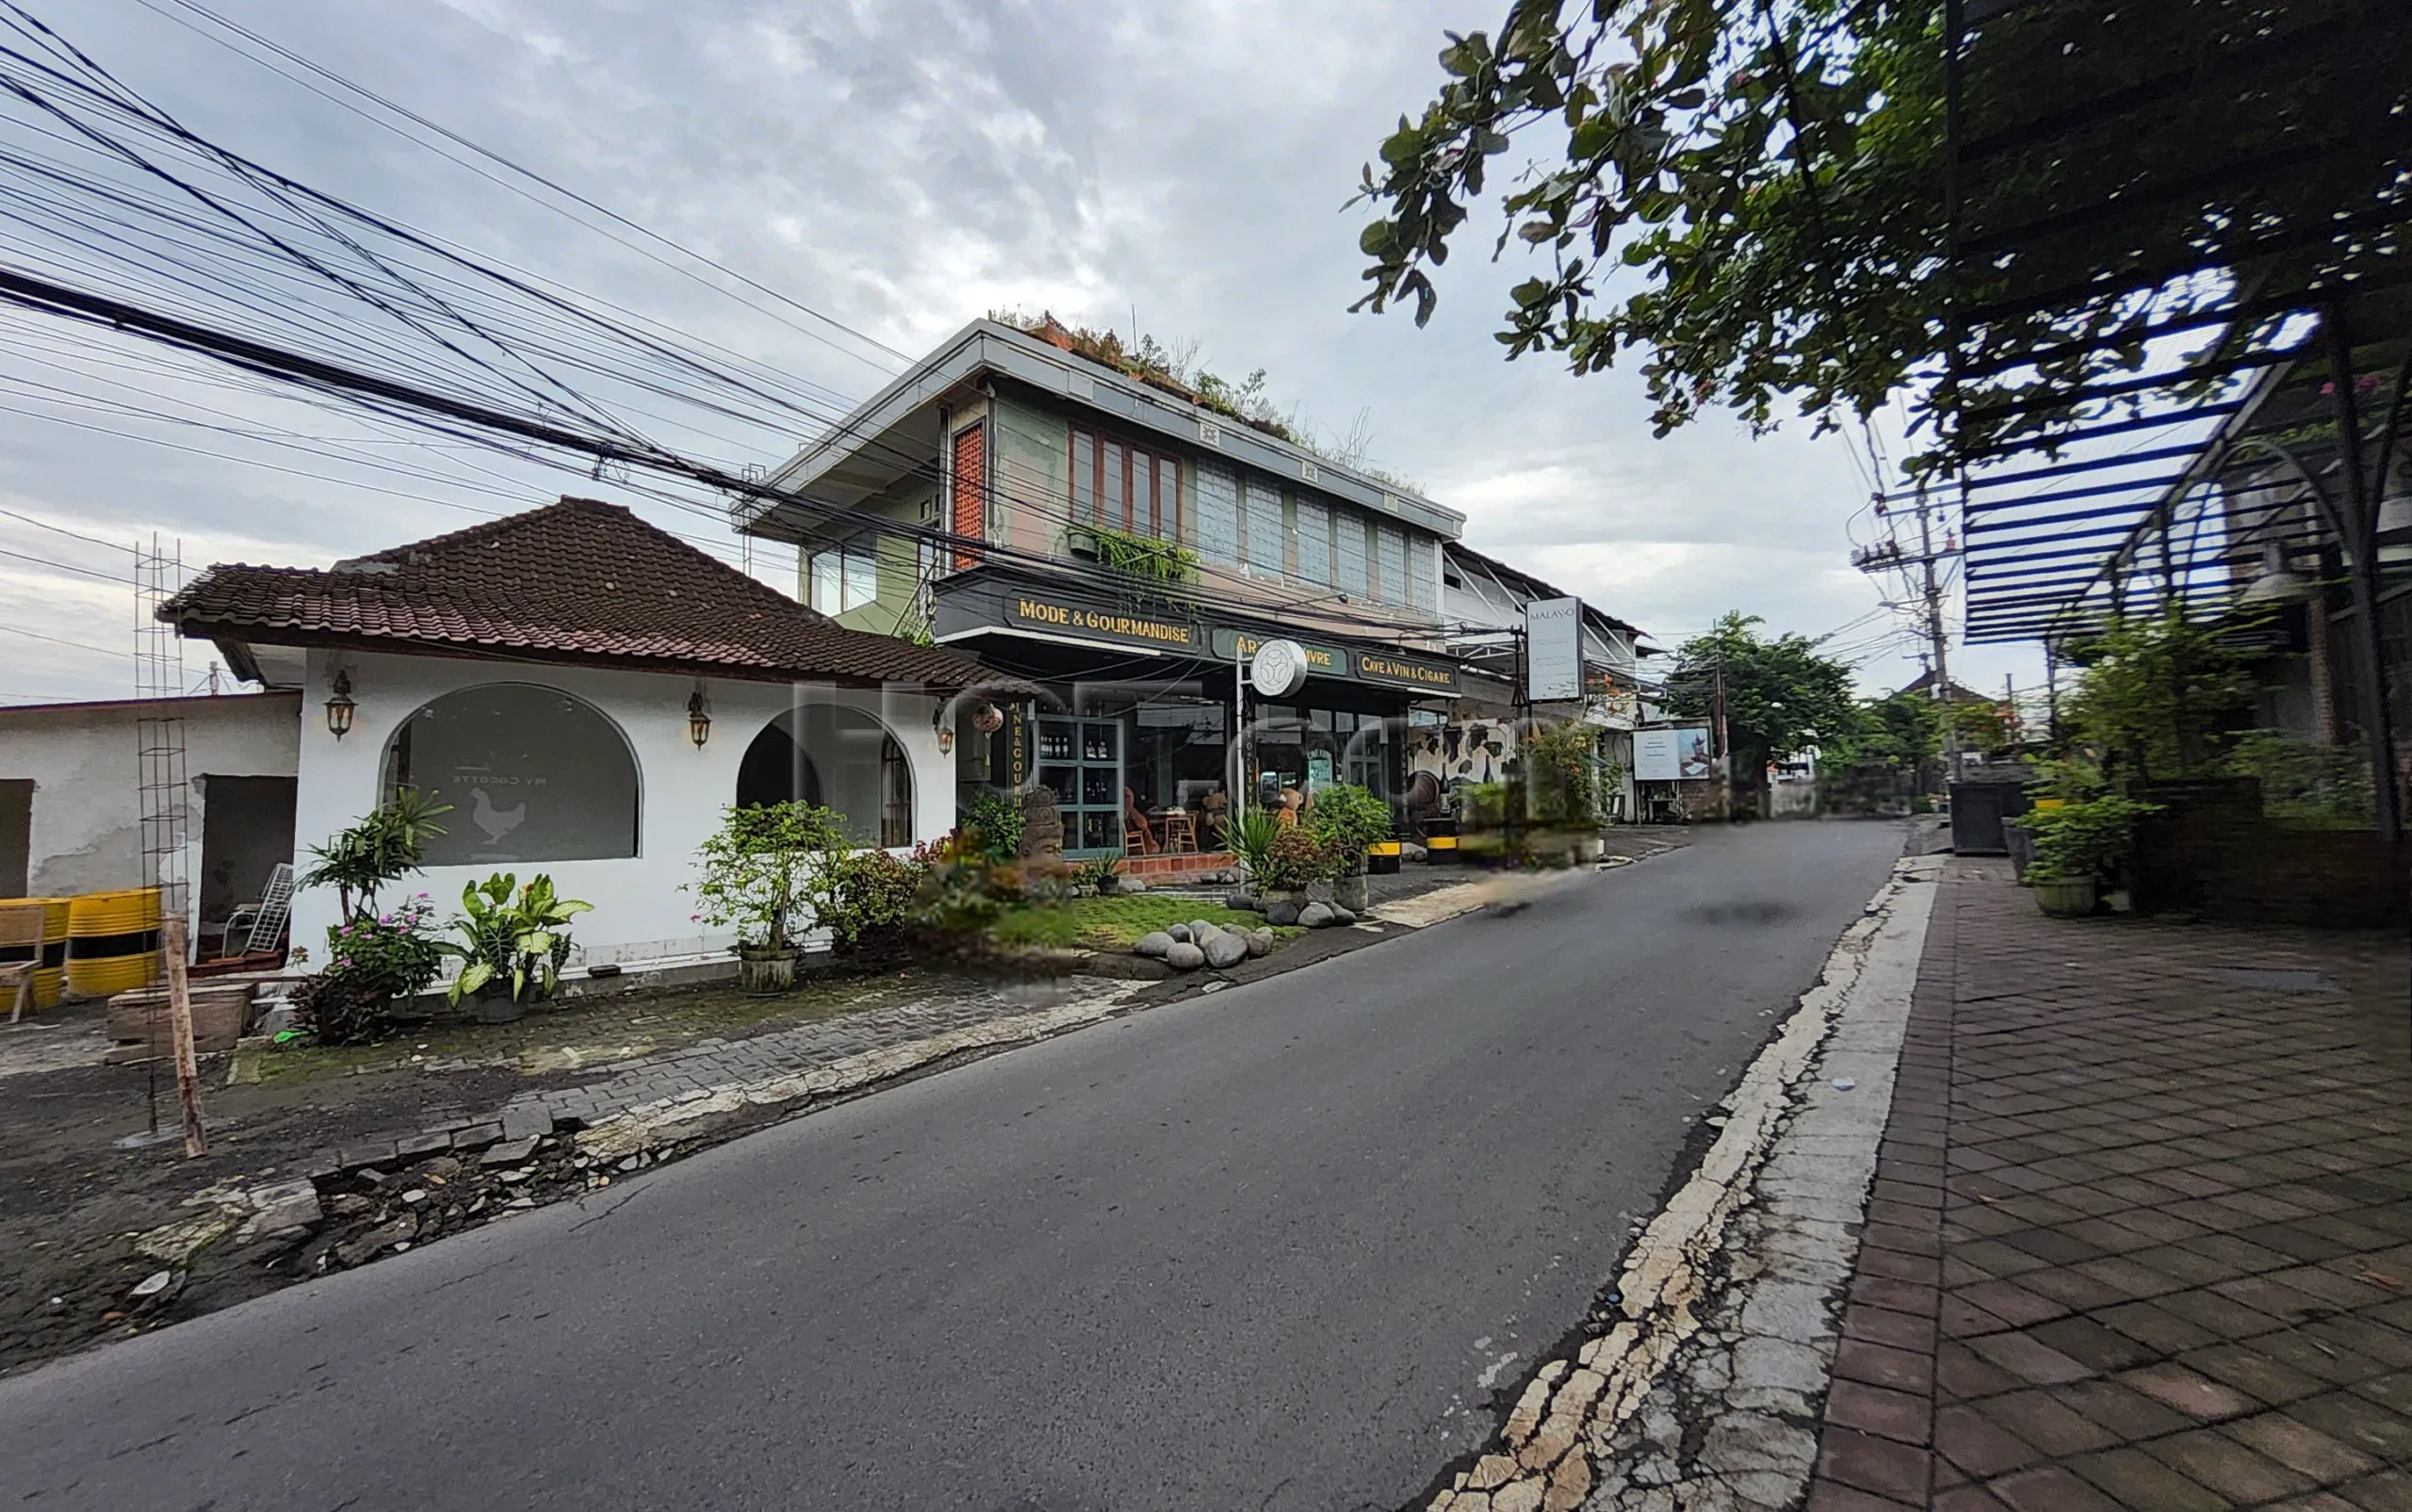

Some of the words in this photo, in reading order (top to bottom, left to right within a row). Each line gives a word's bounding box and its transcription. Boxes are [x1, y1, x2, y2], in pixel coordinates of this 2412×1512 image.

[1019, 598, 1068, 625] MODE
[1072, 611, 1084, 626] &
[1086, 610, 1189, 642] GOURMANDISE
[1361, 657, 1385, 674] CAVE
[1393, 661, 1410, 678] VIN
[1411, 667, 1417, 679] &
[1418, 666, 1451, 684] CIGARE
